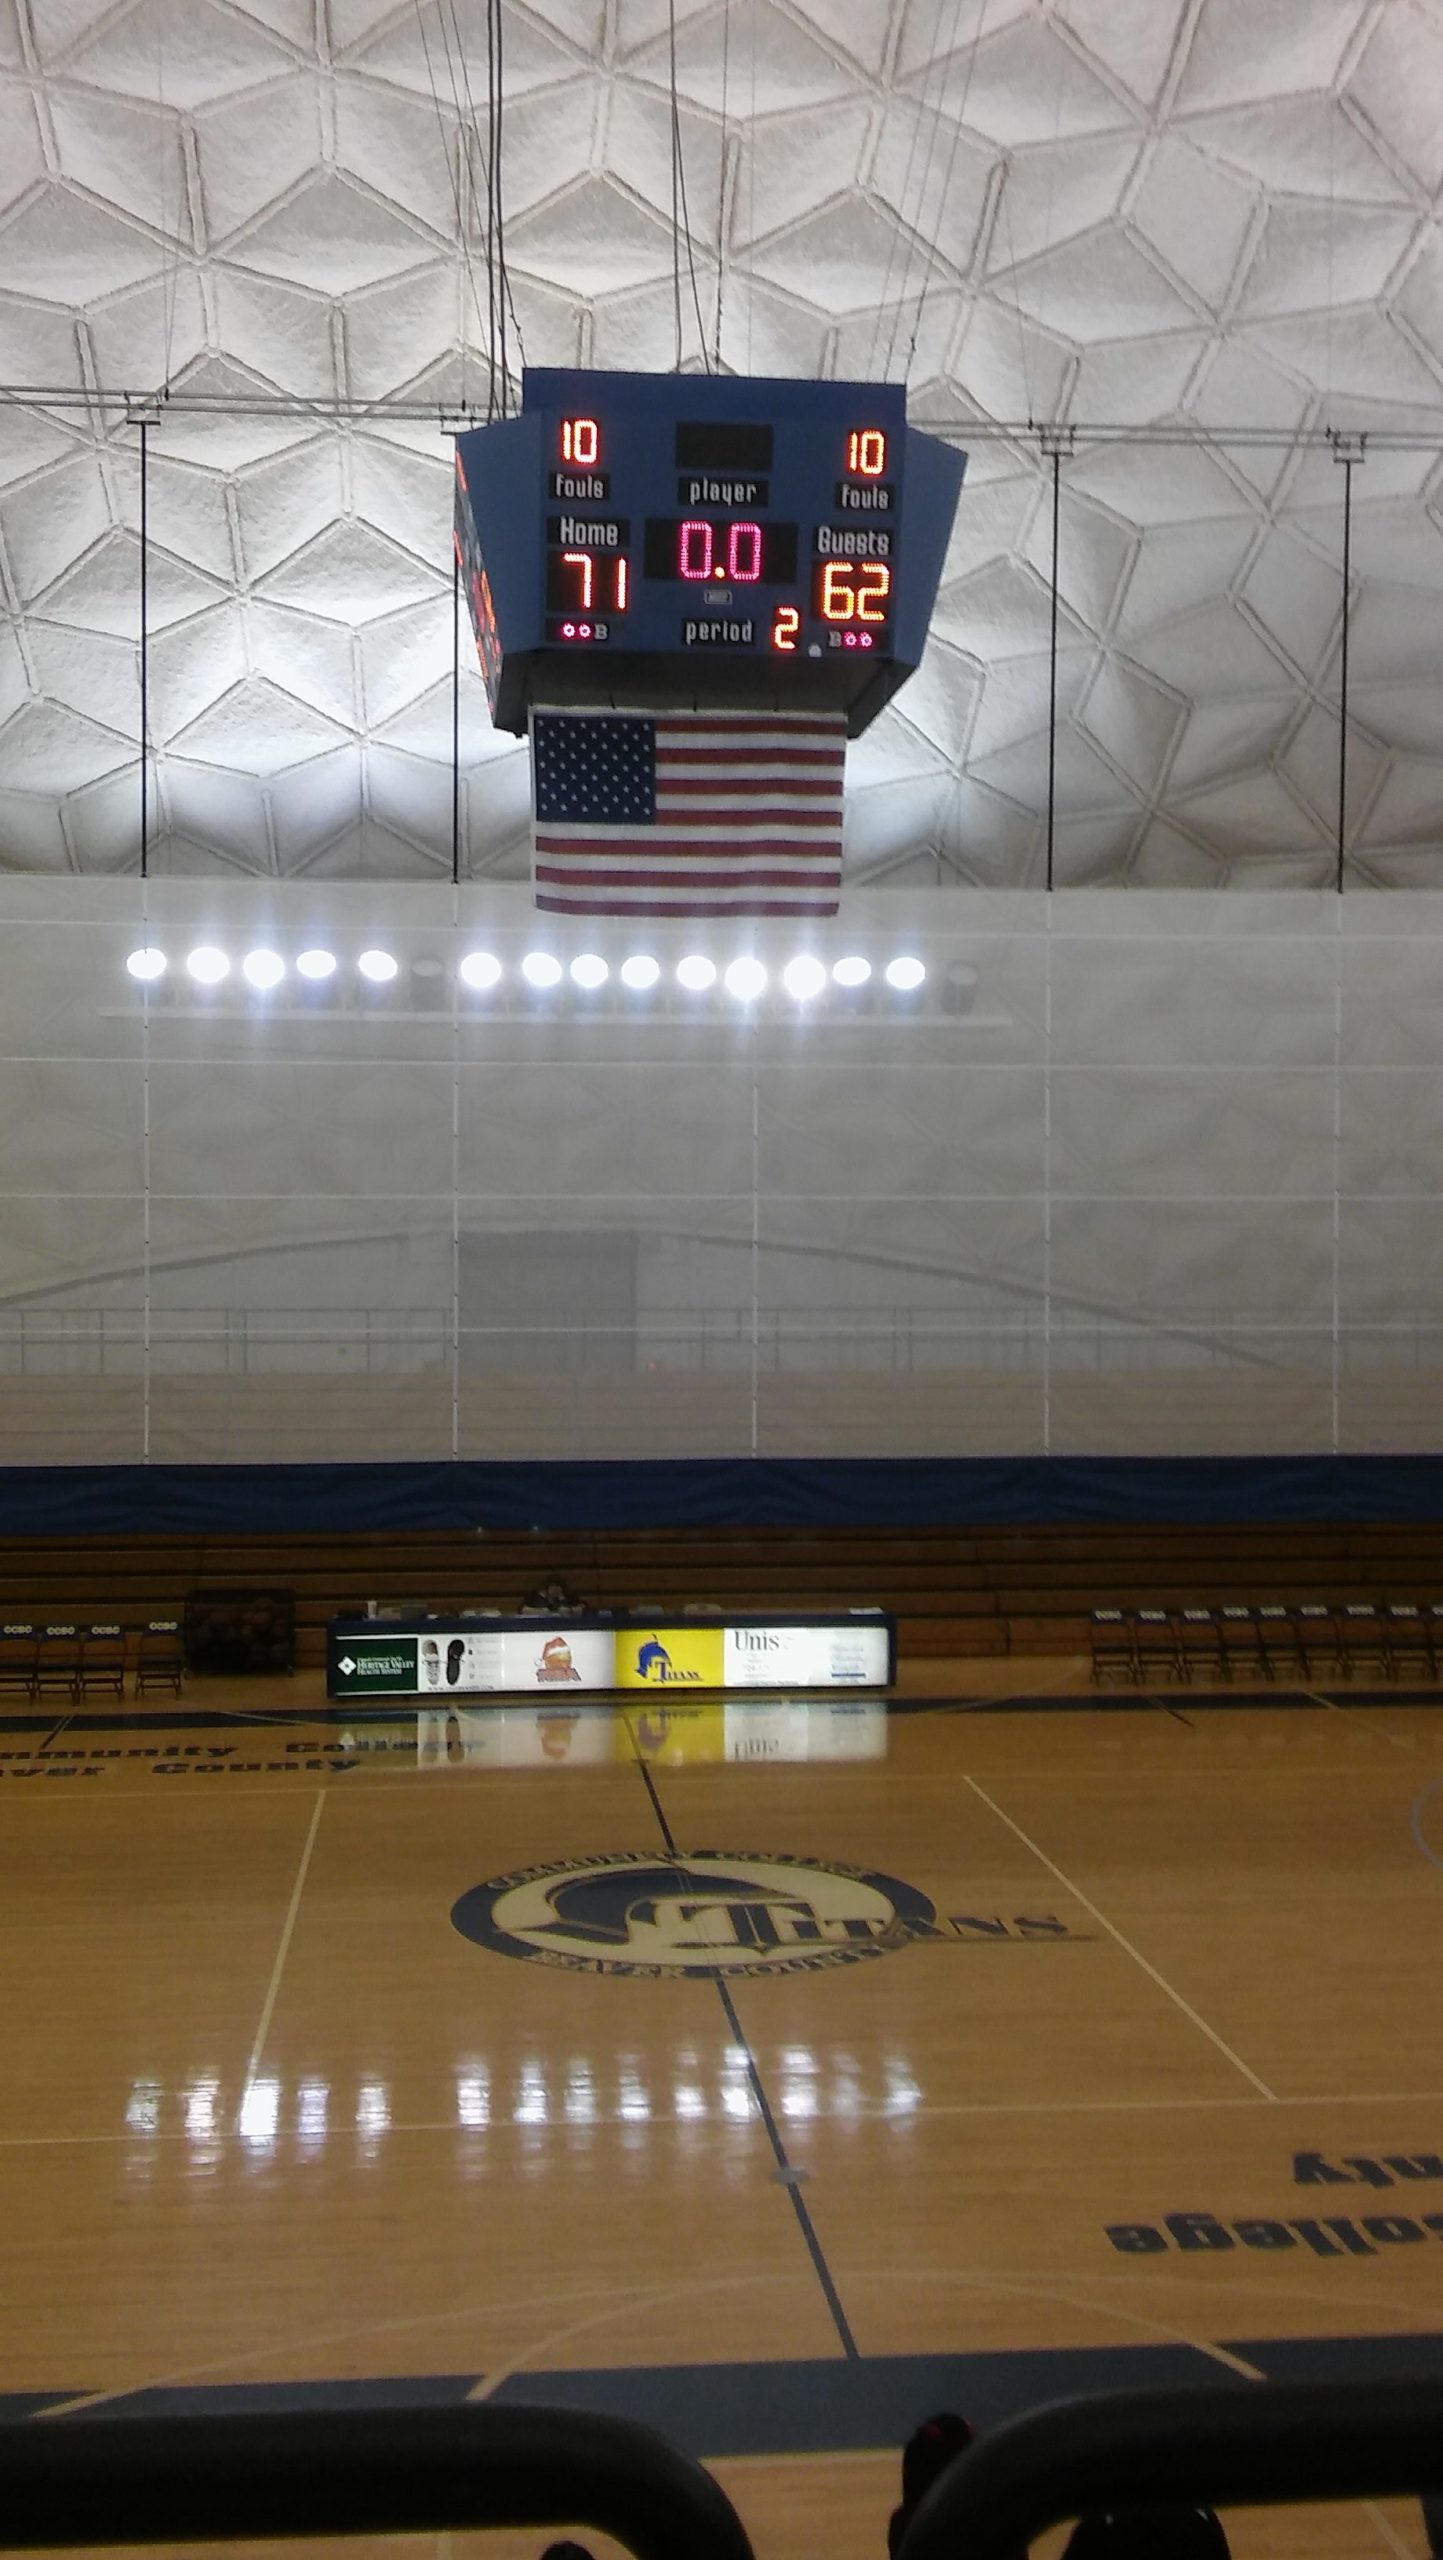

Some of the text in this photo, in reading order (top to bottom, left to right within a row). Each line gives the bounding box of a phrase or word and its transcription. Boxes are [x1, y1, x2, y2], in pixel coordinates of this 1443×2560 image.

[562, 418, 598, 464] 10
[849, 430, 886, 475] 10
[555, 474, 605, 499] fouls
[689, 477, 758, 503] player
[841, 485, 889, 510] fouls
[560, 517, 619, 547] Home
[817, 526, 890, 556] Guests
[680, 521, 762, 581] 0.0
[562, 552, 627, 609] 71
[822, 561, 890, 621] 62
[685, 619, 753, 646] period
[774, 606, 799, 650] 2
